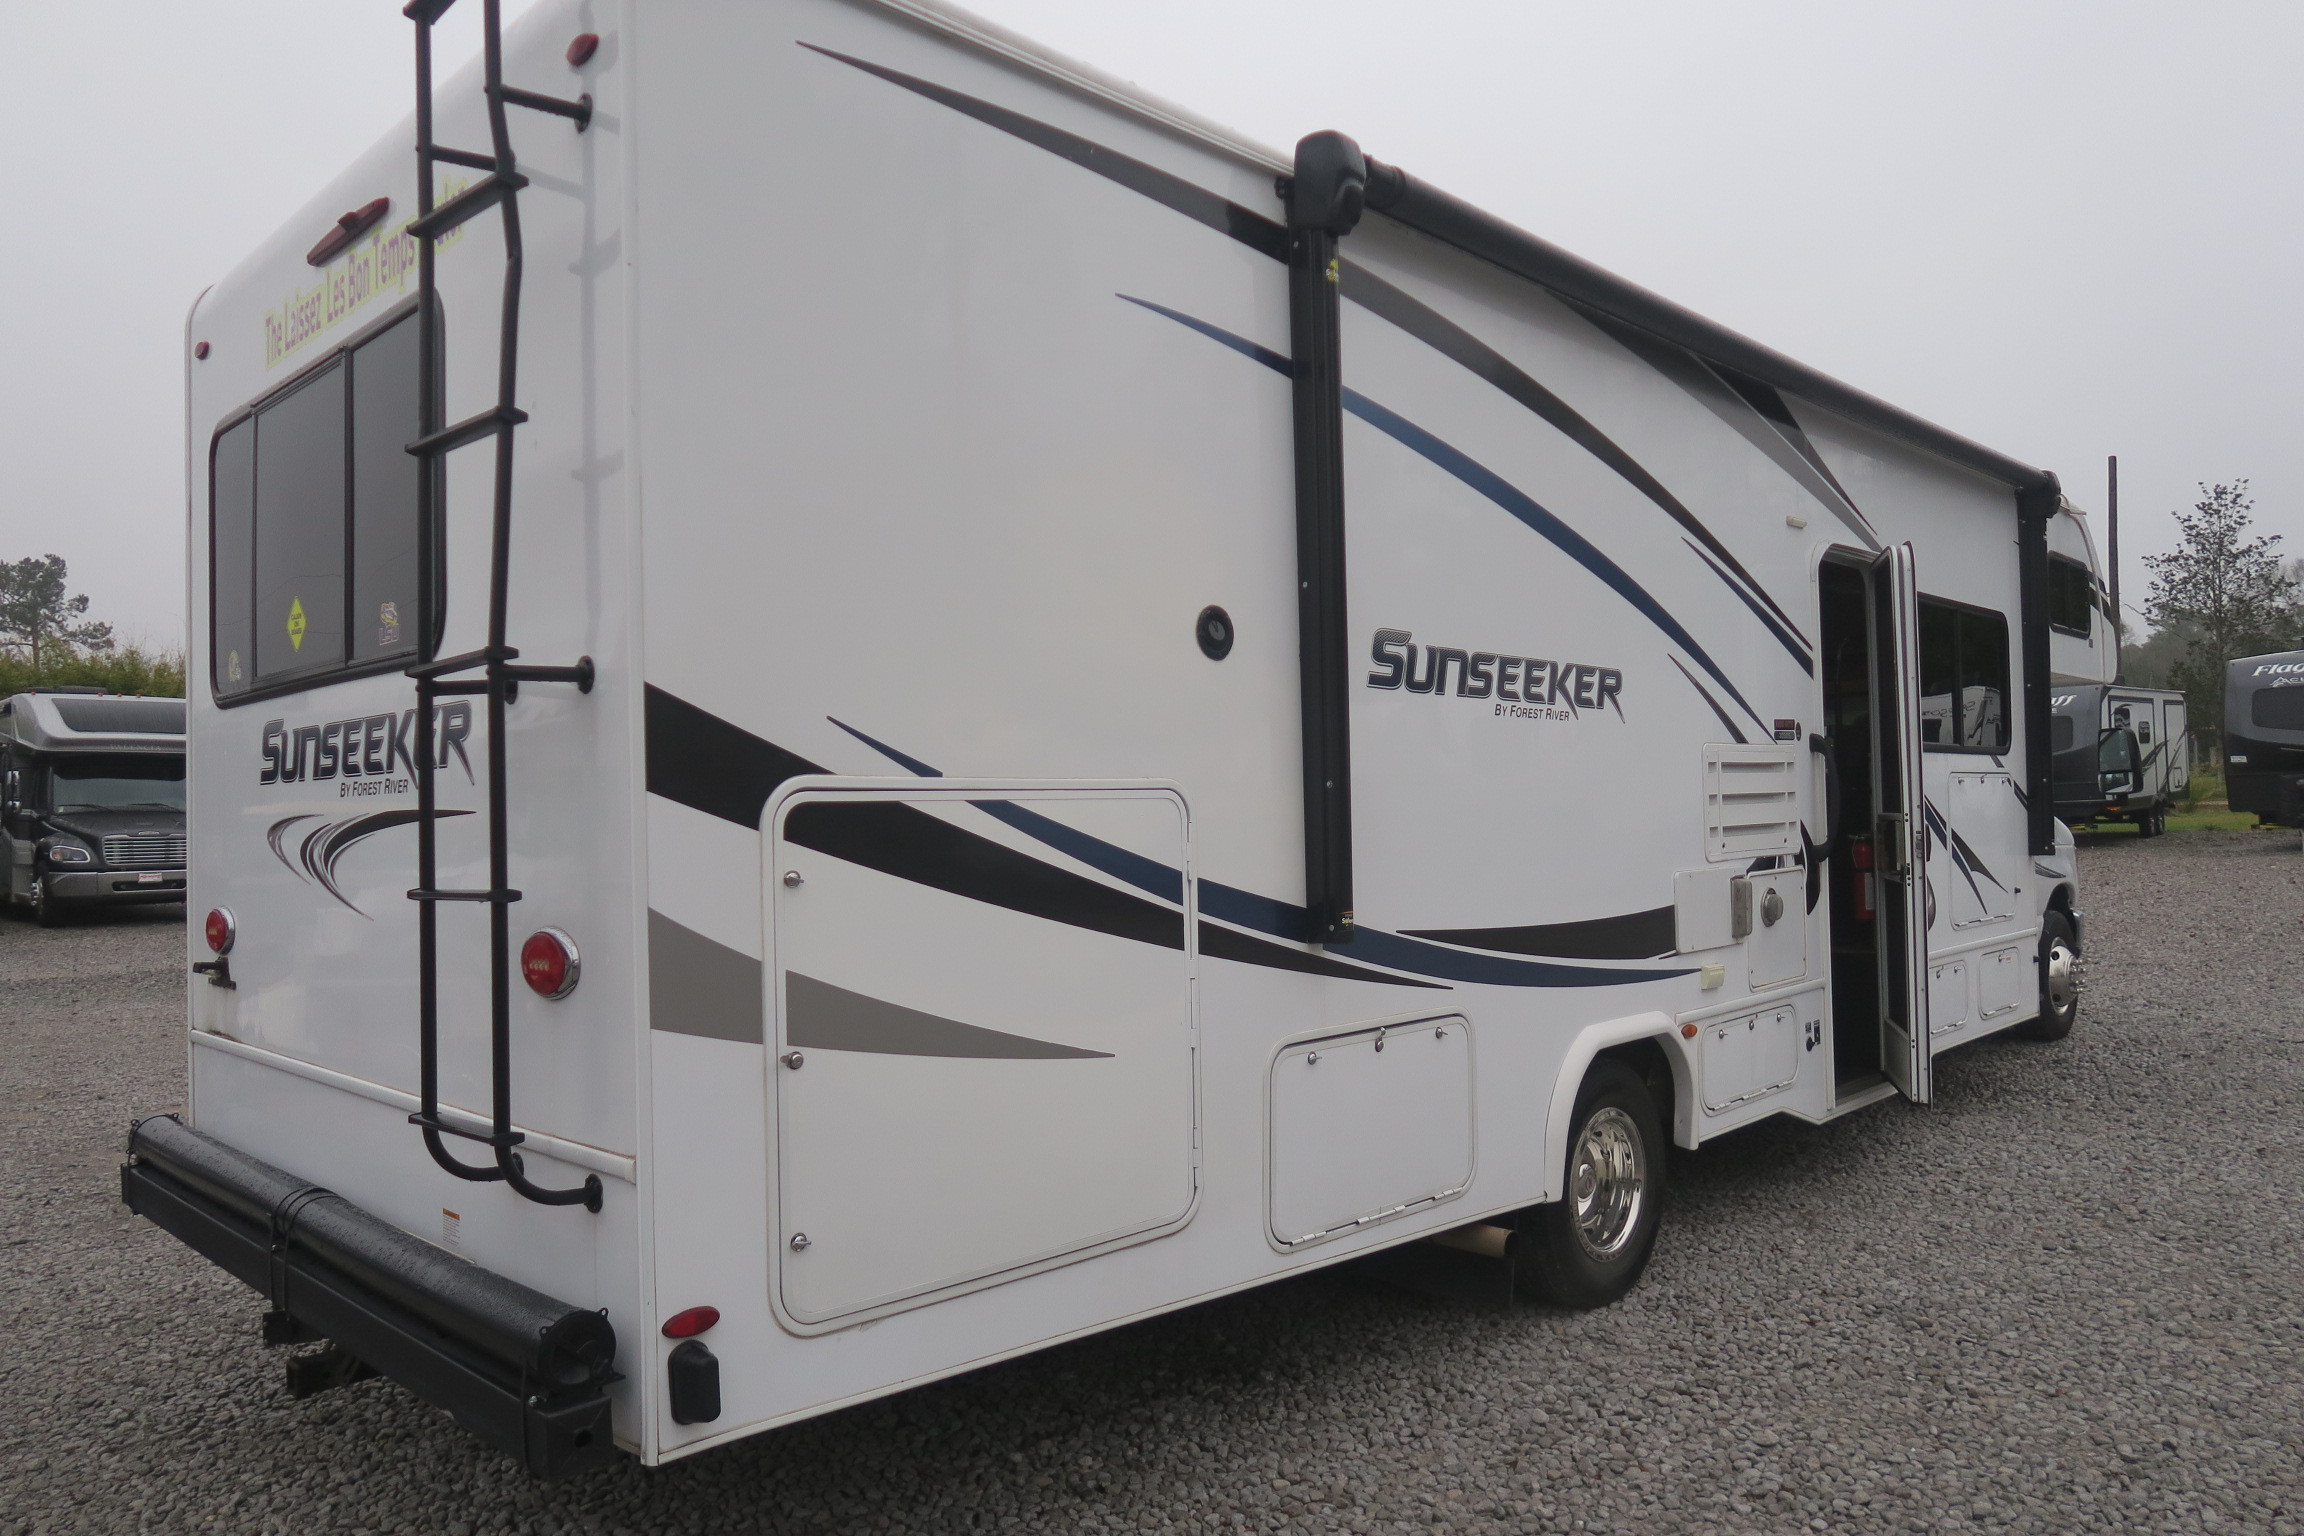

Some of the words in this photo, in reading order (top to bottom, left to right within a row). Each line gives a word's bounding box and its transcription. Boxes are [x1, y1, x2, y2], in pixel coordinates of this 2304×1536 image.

[264, 315, 283, 365] The
[284, 292, 322, 352] Laissez
[326, 270, 347, 323] Les
[348, 253, 370, 308] Bon
[373, 228, 416, 290] Temps
[1509, 705, 1544, 720] FOREST
[1545, 707, 1570, 721] RIVER
[352, 781, 383, 797] FOREST
[384, 778, 409, 794] RIVER
